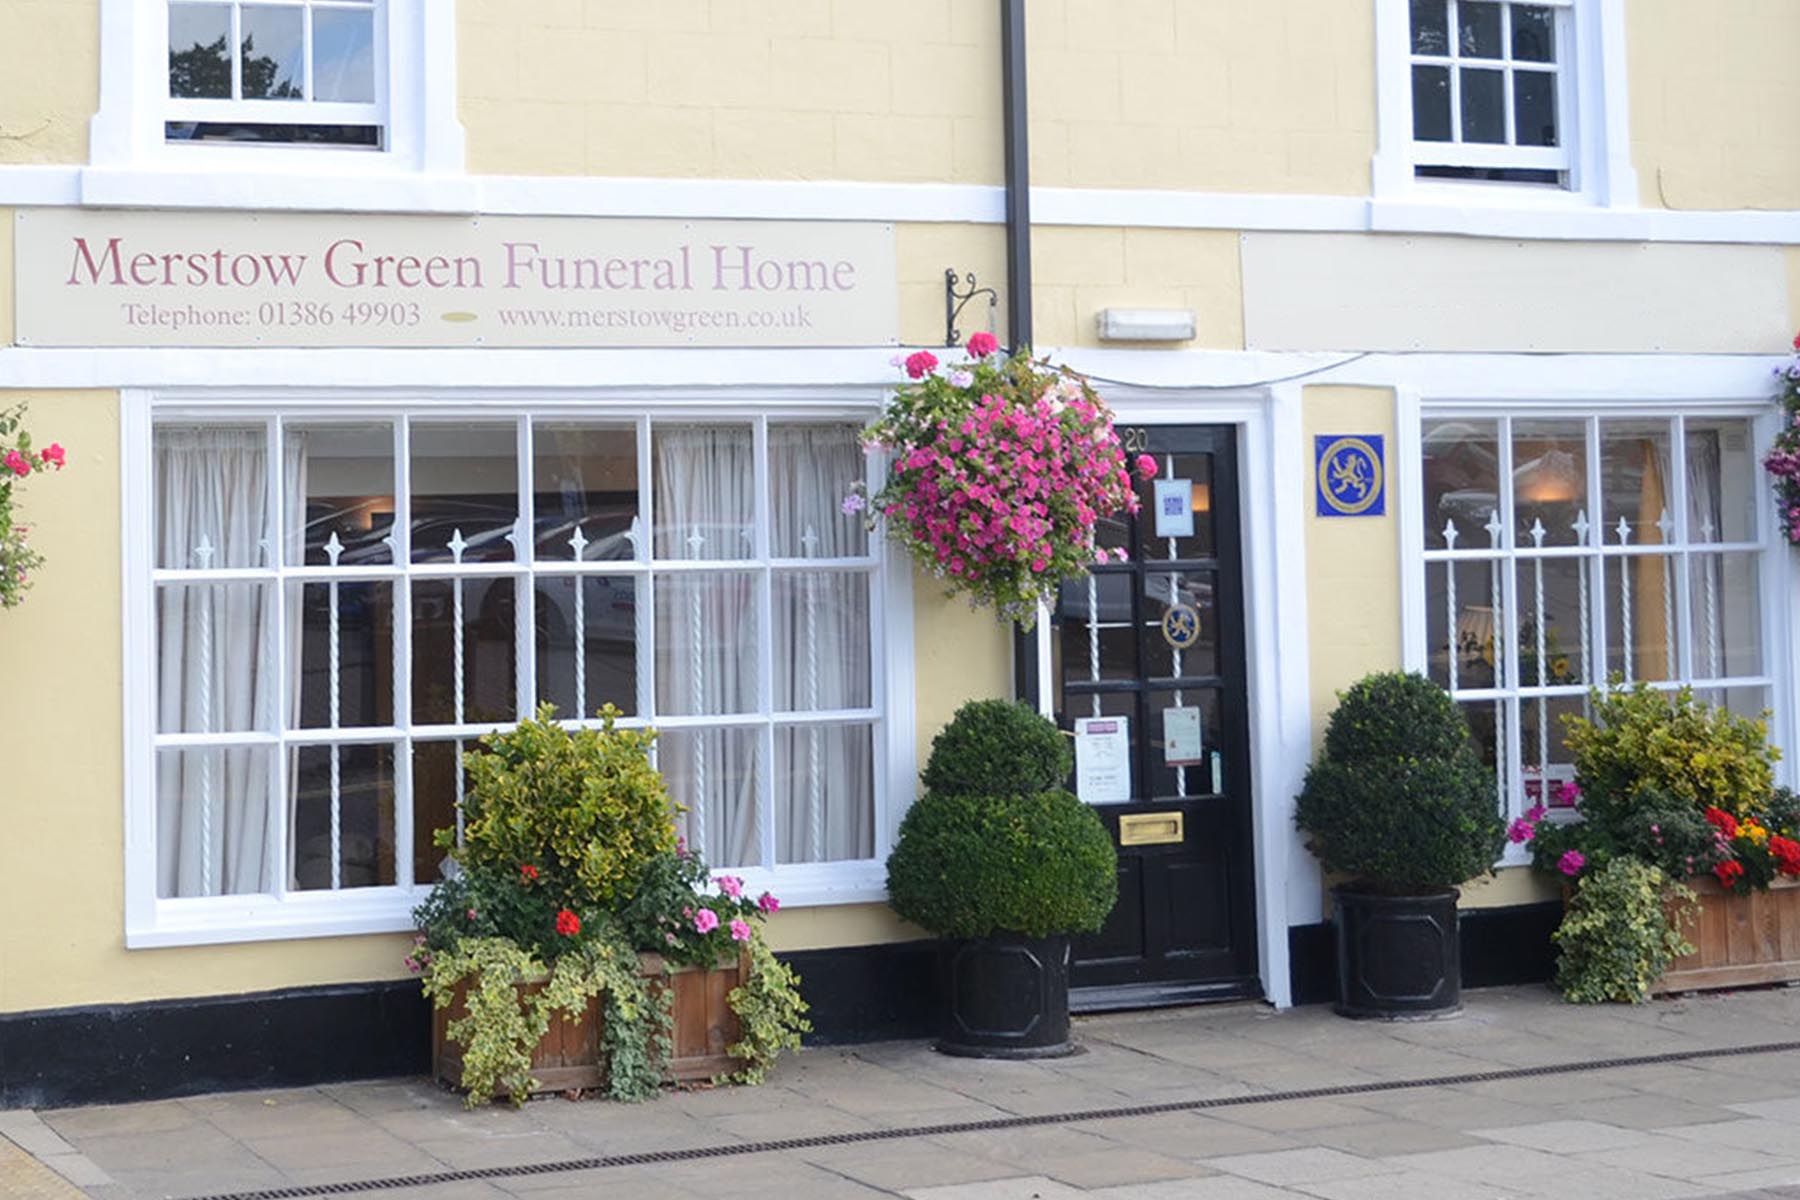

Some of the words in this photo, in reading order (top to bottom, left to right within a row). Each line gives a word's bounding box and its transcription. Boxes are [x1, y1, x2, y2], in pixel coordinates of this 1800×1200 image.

[66, 237, 307, 286] Merstow
[324, 239, 485, 288] Green
[502, 242, 694, 290] Funeral
[710, 245, 855, 291] Home
[120, 302, 251, 330] Telephone:
[258, 301, 335, 327] 01386
[341, 302, 421, 327] 49903
[499, 304, 812, 333] www.merstowgreen.co.uk
[1124, 427, 1148, 452] 20
